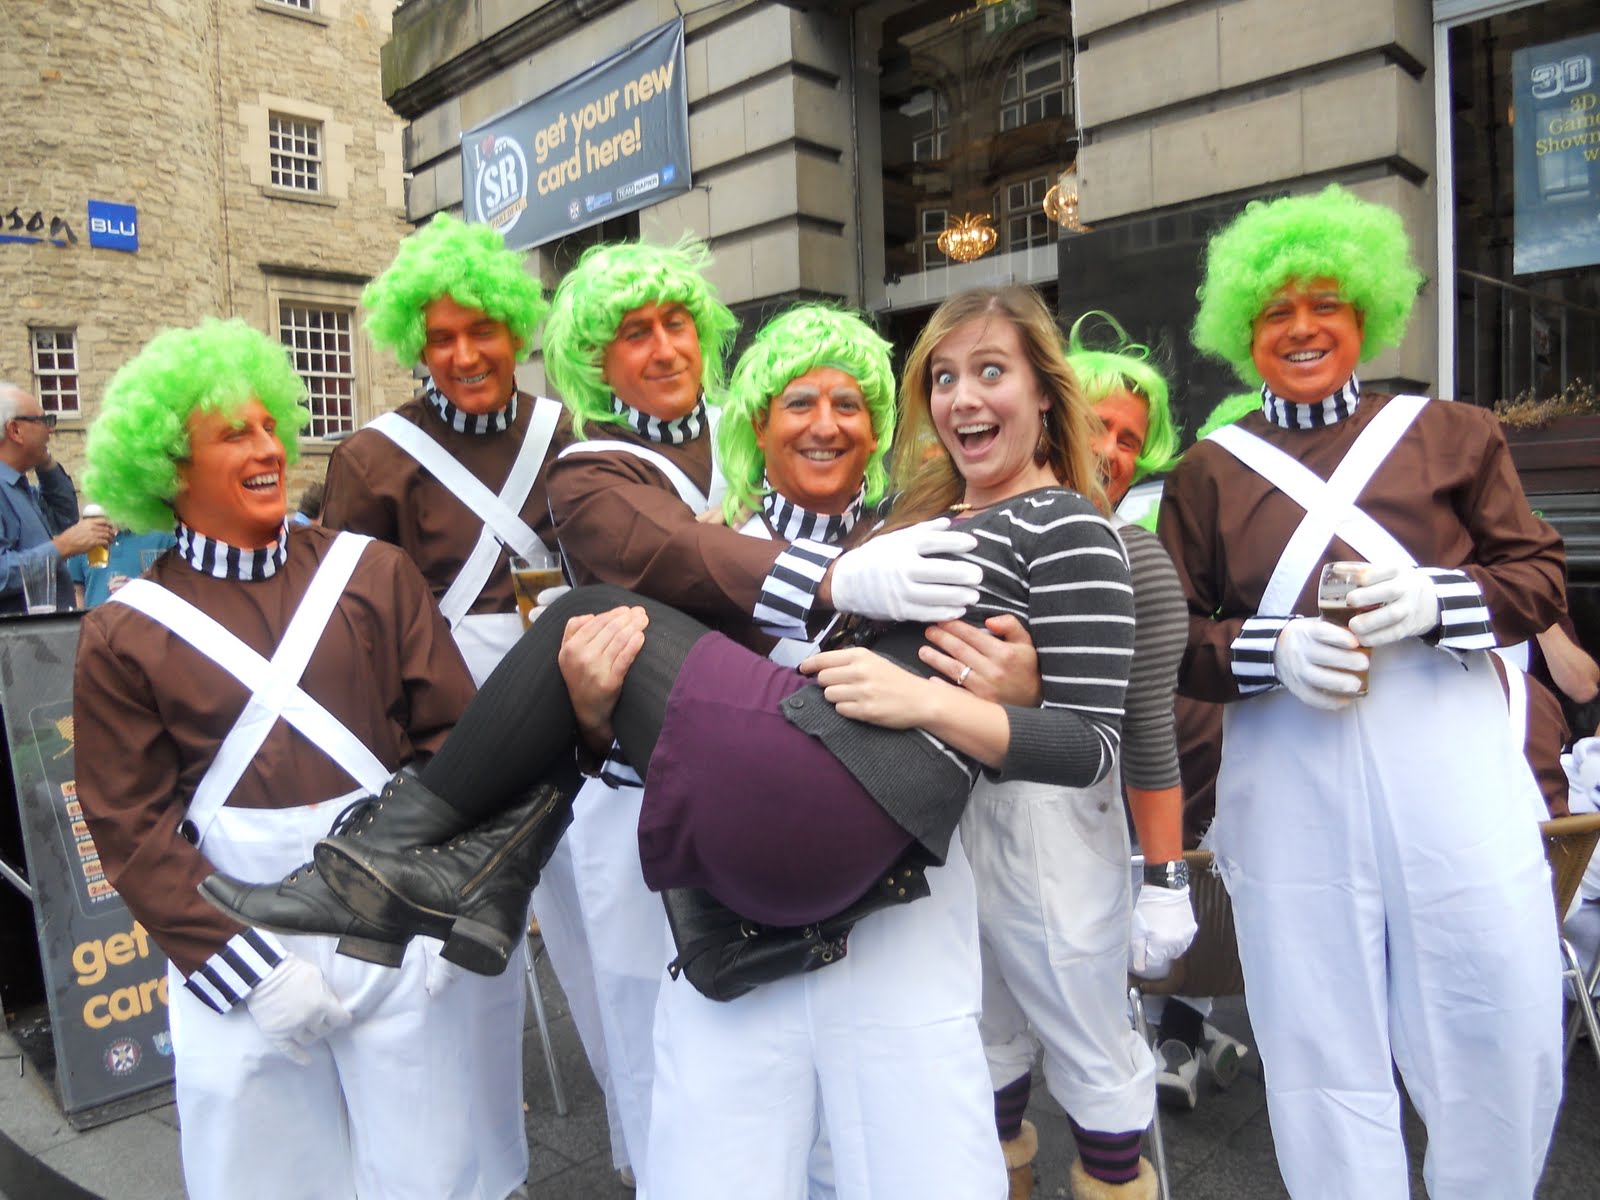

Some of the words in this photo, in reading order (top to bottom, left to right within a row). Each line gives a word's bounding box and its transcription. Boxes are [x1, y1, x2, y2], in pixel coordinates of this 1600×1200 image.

[535, 112, 567, 164] get
[571, 90, 619, 146] your
[625, 59, 674, 110] new
[484, 154, 518, 209] SR
[537, 145, 581, 196] card
[585, 116, 642, 174] here!
[91, 217, 136, 237] BLU
[72, 919, 149, 986] get
